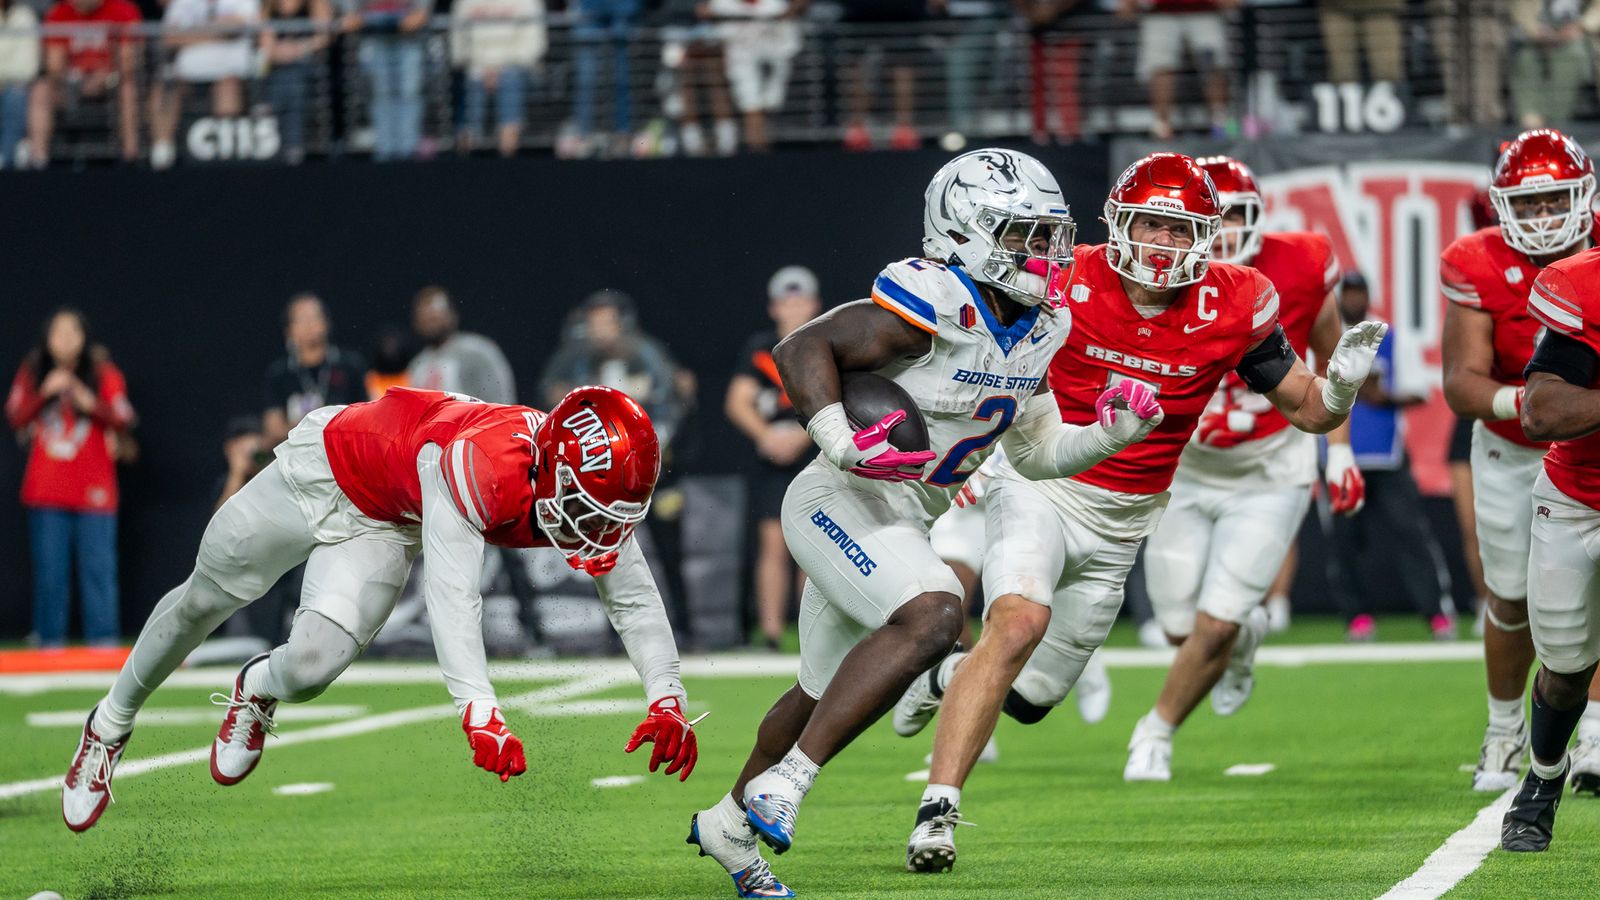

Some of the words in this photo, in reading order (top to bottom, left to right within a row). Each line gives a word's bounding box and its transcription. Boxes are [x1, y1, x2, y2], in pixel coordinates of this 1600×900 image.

[1312, 82, 1406, 133] 116
[187, 117, 281, 160] C115
[1150, 201, 1183, 211] VEGAS
[1197, 286, 1219, 321] C
[952, 368, 1004, 389] BOISE
[1005, 376, 1041, 391] STATE
[1085, 344, 1198, 377] REBELS
[562, 407, 613, 474] UNLV
[924, 394, 1018, 488] 2
[810, 510, 878, 577] BRONCOS
